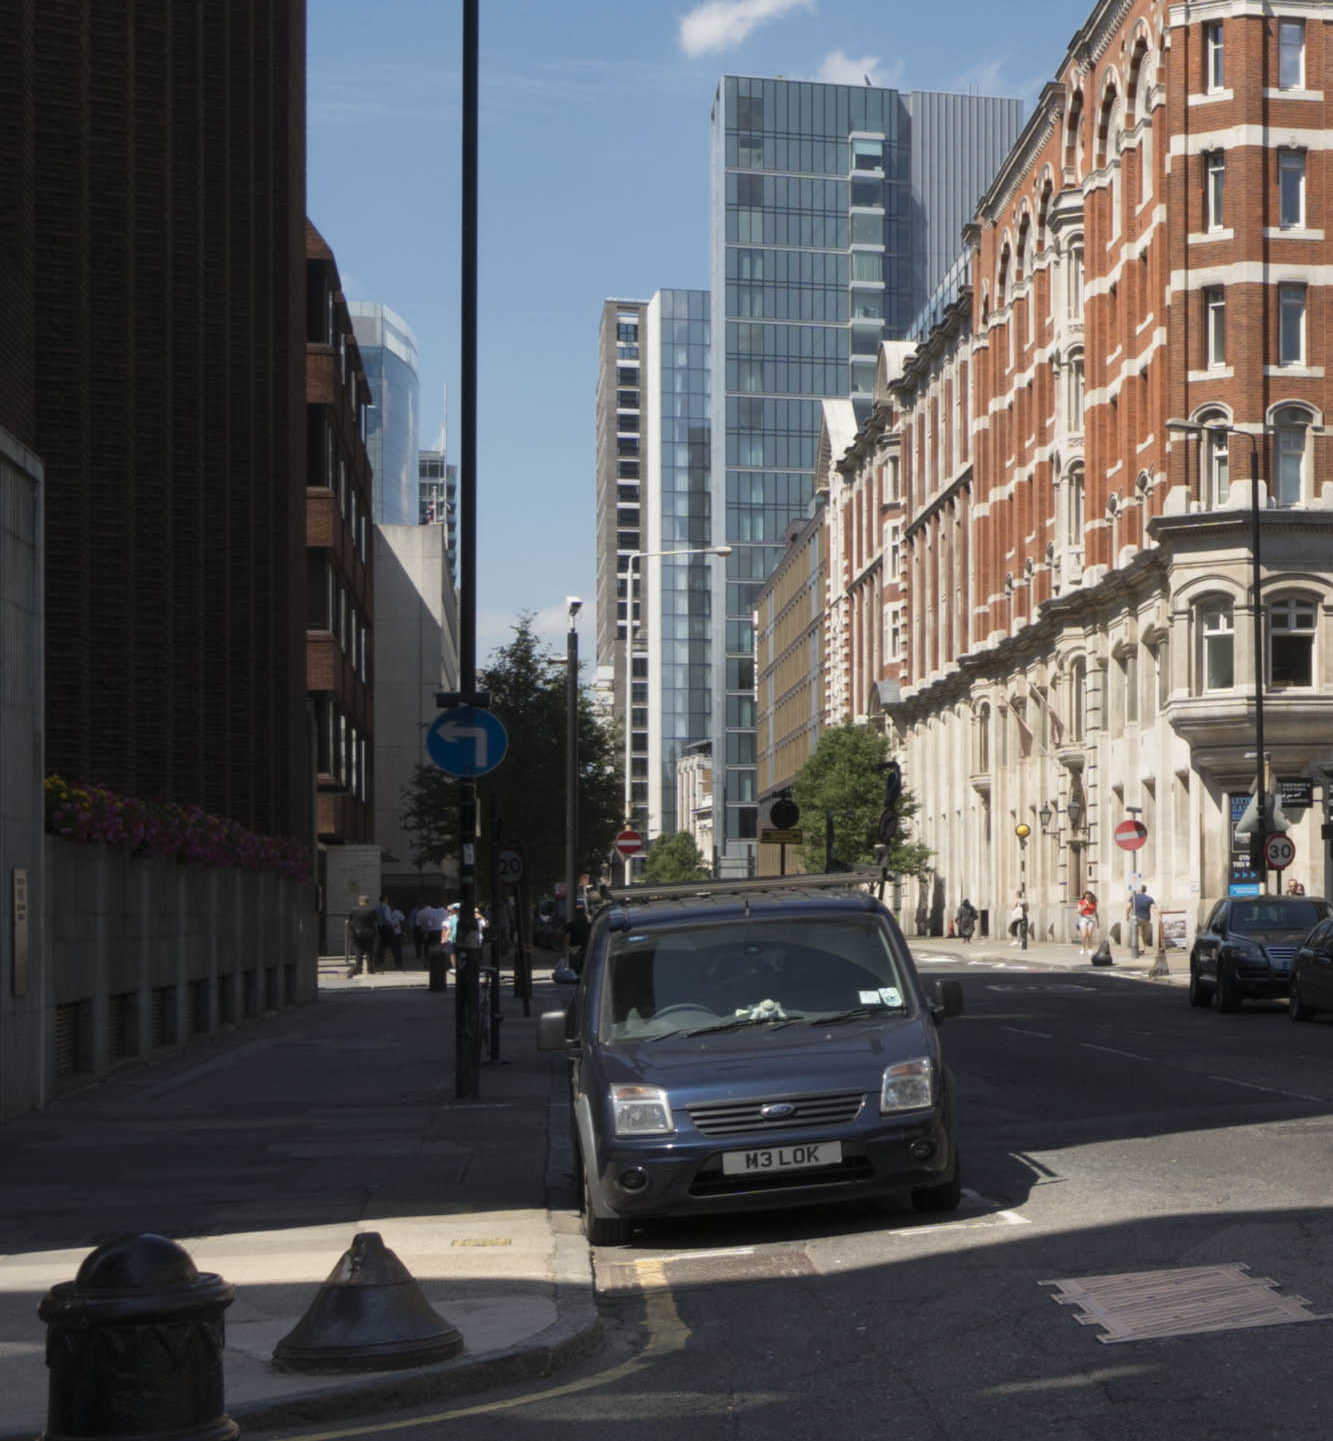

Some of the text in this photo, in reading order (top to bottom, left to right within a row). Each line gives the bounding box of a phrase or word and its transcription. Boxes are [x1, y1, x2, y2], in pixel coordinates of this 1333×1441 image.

[1269, 844, 1292, 859] 30
[499, 857, 521, 875] 20
[745, 1145, 820, 1169] M3 LOK
